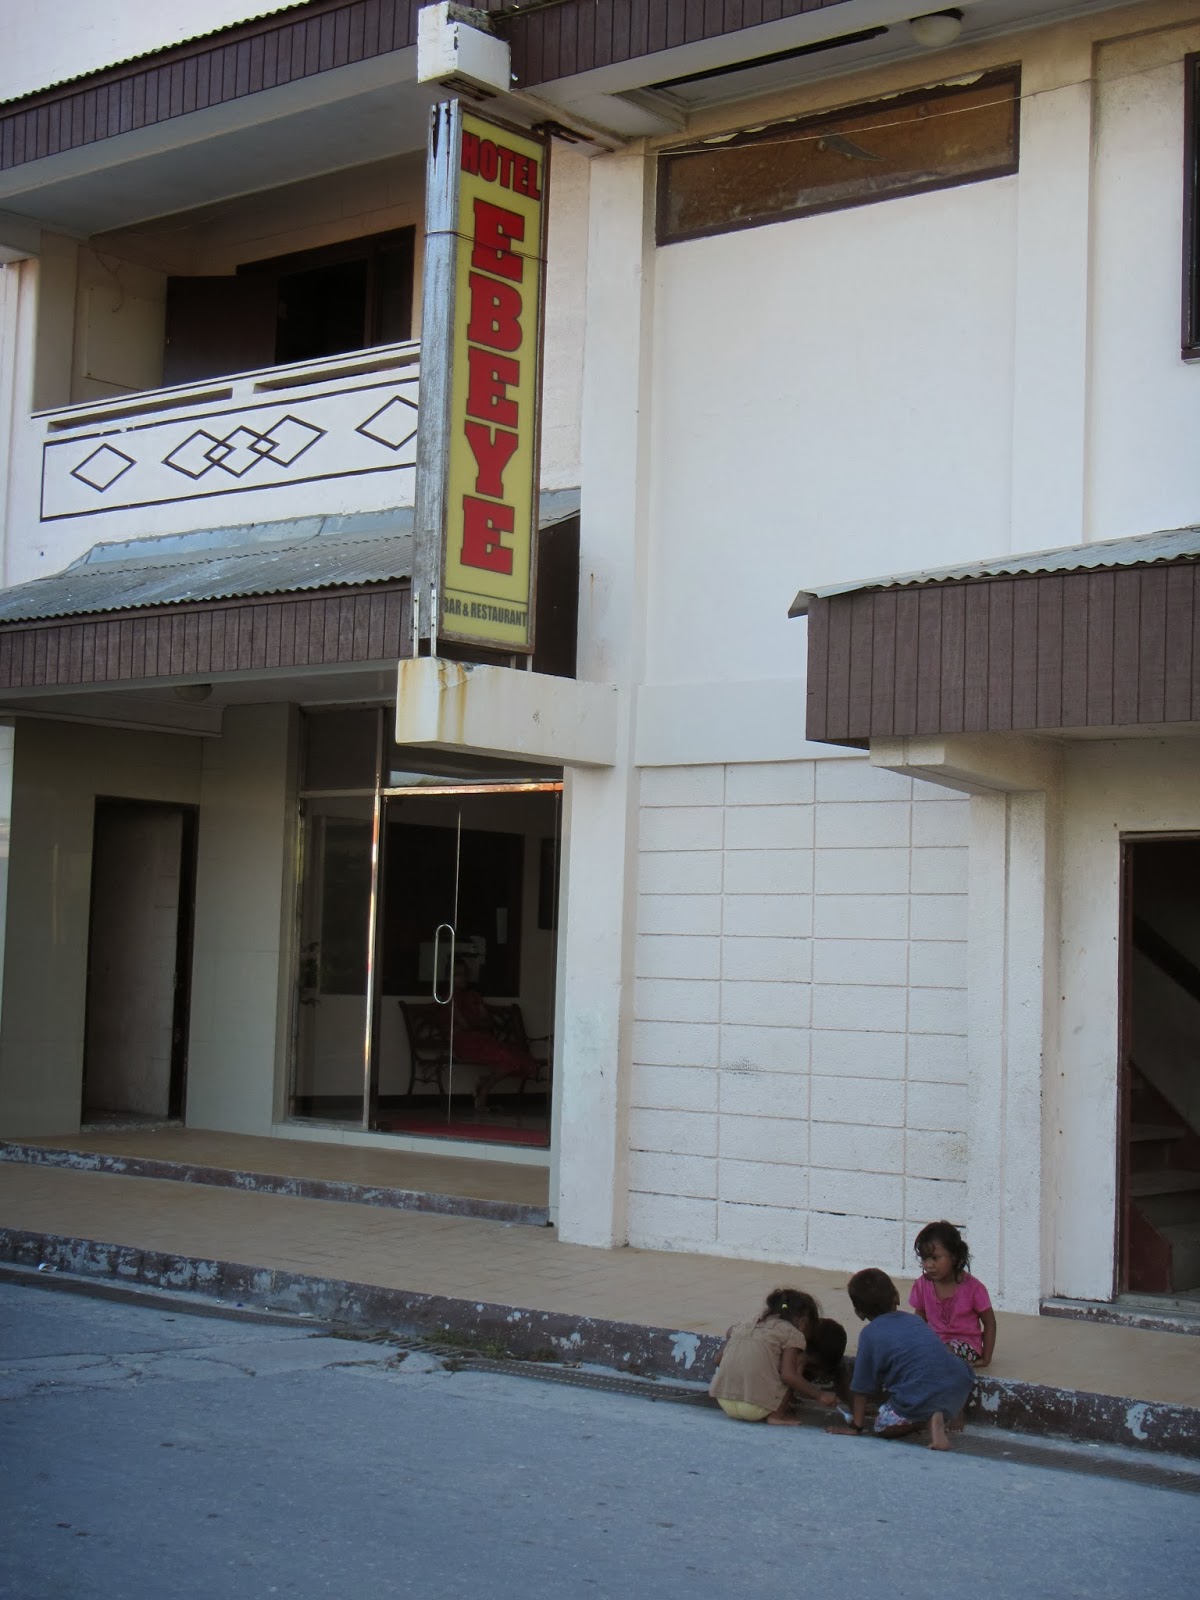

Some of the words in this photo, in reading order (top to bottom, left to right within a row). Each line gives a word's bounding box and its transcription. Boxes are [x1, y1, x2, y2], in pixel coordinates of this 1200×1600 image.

[460, 129, 541, 202] HOTEL
[459, 197, 526, 576] EBEYE
[443, 597, 462, 617] BAR
[462, 601, 470, 617] &
[470, 602, 528, 628] RESTAURANT
